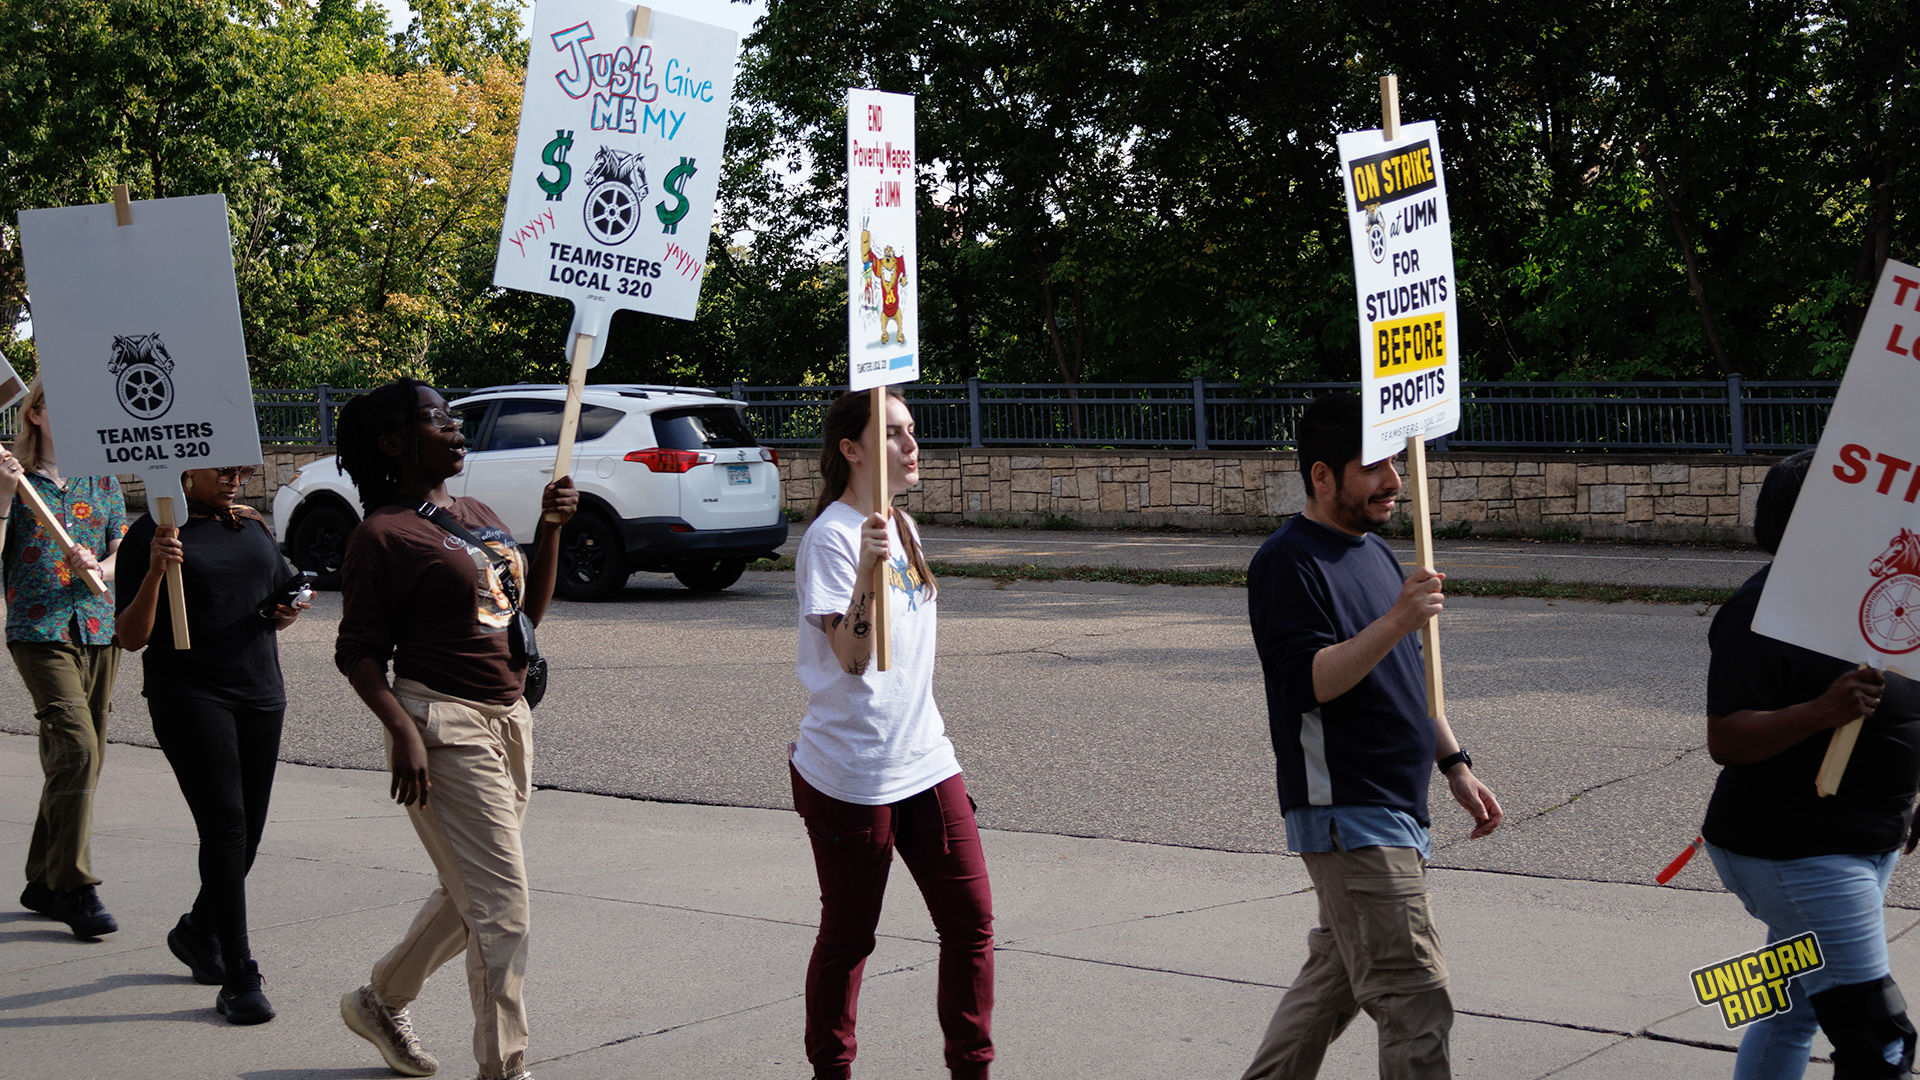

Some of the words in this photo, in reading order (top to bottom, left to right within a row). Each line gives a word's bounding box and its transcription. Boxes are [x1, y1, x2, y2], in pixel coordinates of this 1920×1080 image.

[550, 21, 659, 103] Just
[665, 58, 714, 103] Give
[591, 92, 637, 134] ME
[642, 104, 686, 141] MY
[868, 104, 882, 132] END
[853, 139, 884, 175] Poverty
[885, 141, 911, 176] Wages
[1354, 163, 1380, 202] ON
[1381, 147, 1434, 194] STRIKE
[875, 181, 884, 208] at
[885, 181, 901, 208] UMN
[1390, 210, 1402, 238] at
[1404, 196, 1437, 234] UMN
[549, 242, 662, 279] TEAMSTERS
[1392, 248, 1420, 277] FOR
[550, 264, 611, 292] LOCAL
[617, 278, 652, 299] 320
[1366, 274, 1448, 322] STUDENTS
[1378, 319, 1443, 368] BEFORE
[1380, 368, 1445, 414] PROFITS
[97, 421, 214, 445] TEAMSTERS
[1381, 422, 1419, 442] TEAMSTERS
[105, 444, 169, 463] LOCAL
[174, 441, 211, 457] 320
